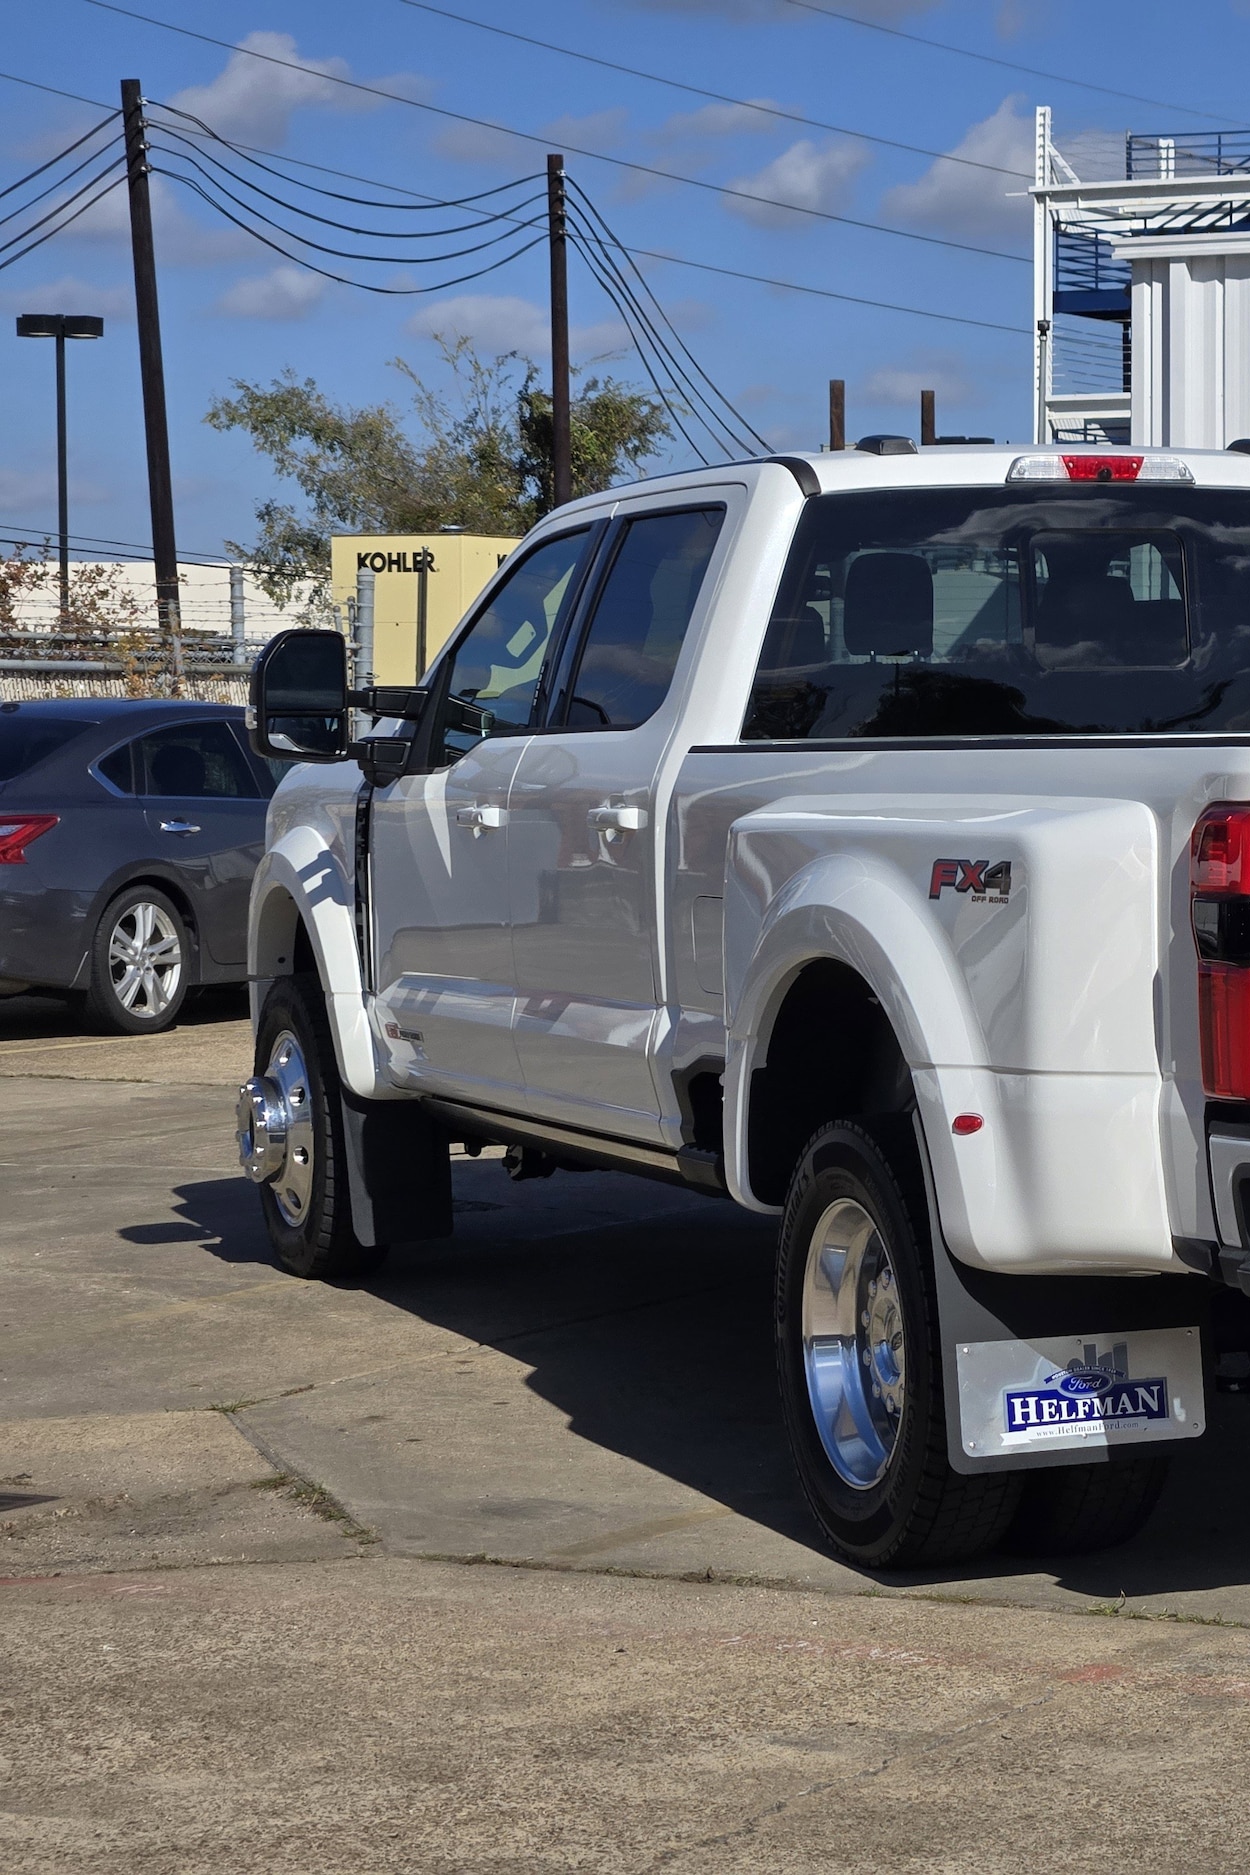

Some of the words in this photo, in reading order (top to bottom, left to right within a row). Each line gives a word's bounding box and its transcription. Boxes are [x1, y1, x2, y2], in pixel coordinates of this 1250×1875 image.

[357, 552, 436, 573] KOHLER
[928, 858, 1012, 900] FX4
[971, 894, 987, 903] OFF
[988, 896, 1009, 904] ROAD
[1068, 1376, 1102, 1391] Ford
[1010, 1385, 1161, 1425] HELFMAN
